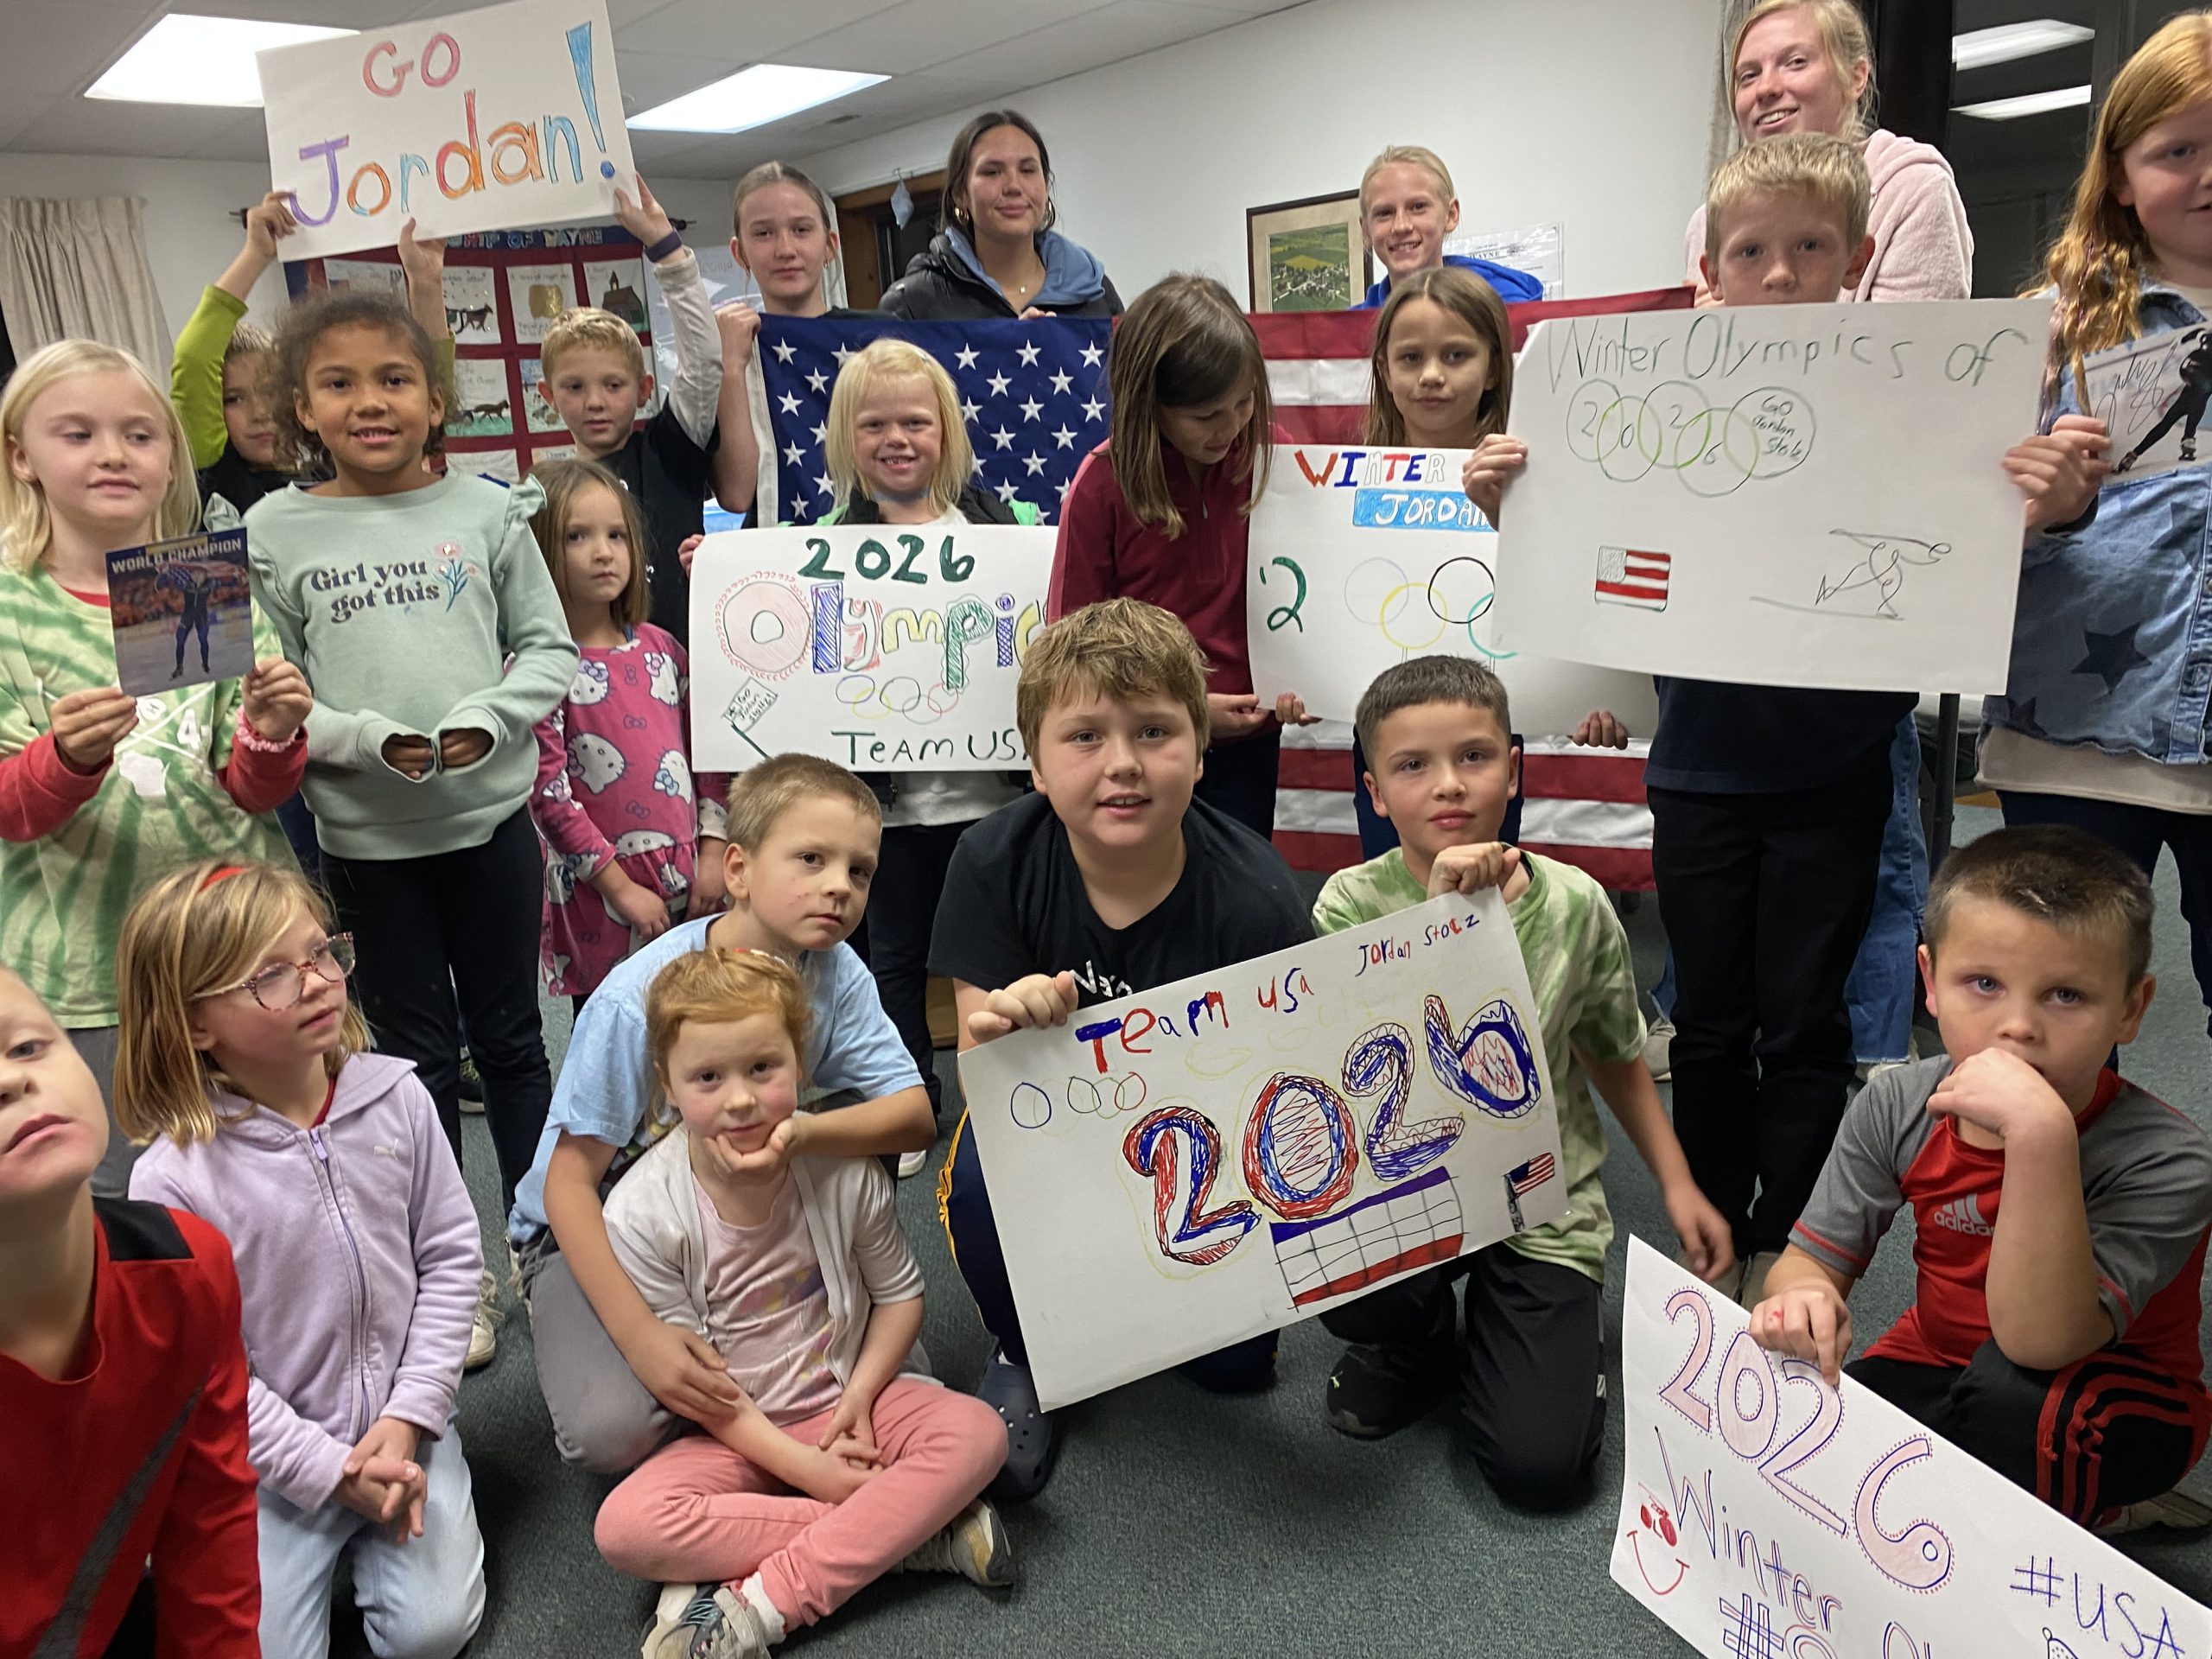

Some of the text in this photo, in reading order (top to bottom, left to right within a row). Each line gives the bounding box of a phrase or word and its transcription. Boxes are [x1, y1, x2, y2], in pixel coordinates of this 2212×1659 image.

[362, 32, 461, 97] GO
[289, 21, 614, 226] Jordan!
[506, 231, 534, 249] OF
[543, 227, 603, 248] WAYNE
[1546, 317, 1670, 393] Winter
[1683, 313, 1913, 379] Olympics
[111, 537, 242, 575] WORLD CHAMPION
[311, 559, 428, 592] Girl you
[798, 534, 976, 584] 2026
[331, 581, 440, 624] got this
[967, 728, 1030, 761] US
[1122, 995, 1543, 1265] 2026
[1934, 1211, 1995, 1236] adida
[1659, 1287, 1955, 1595] 2026
[1654, 1426, 1843, 1633] Winter
[2010, 1555, 2185, 1659] #USA
